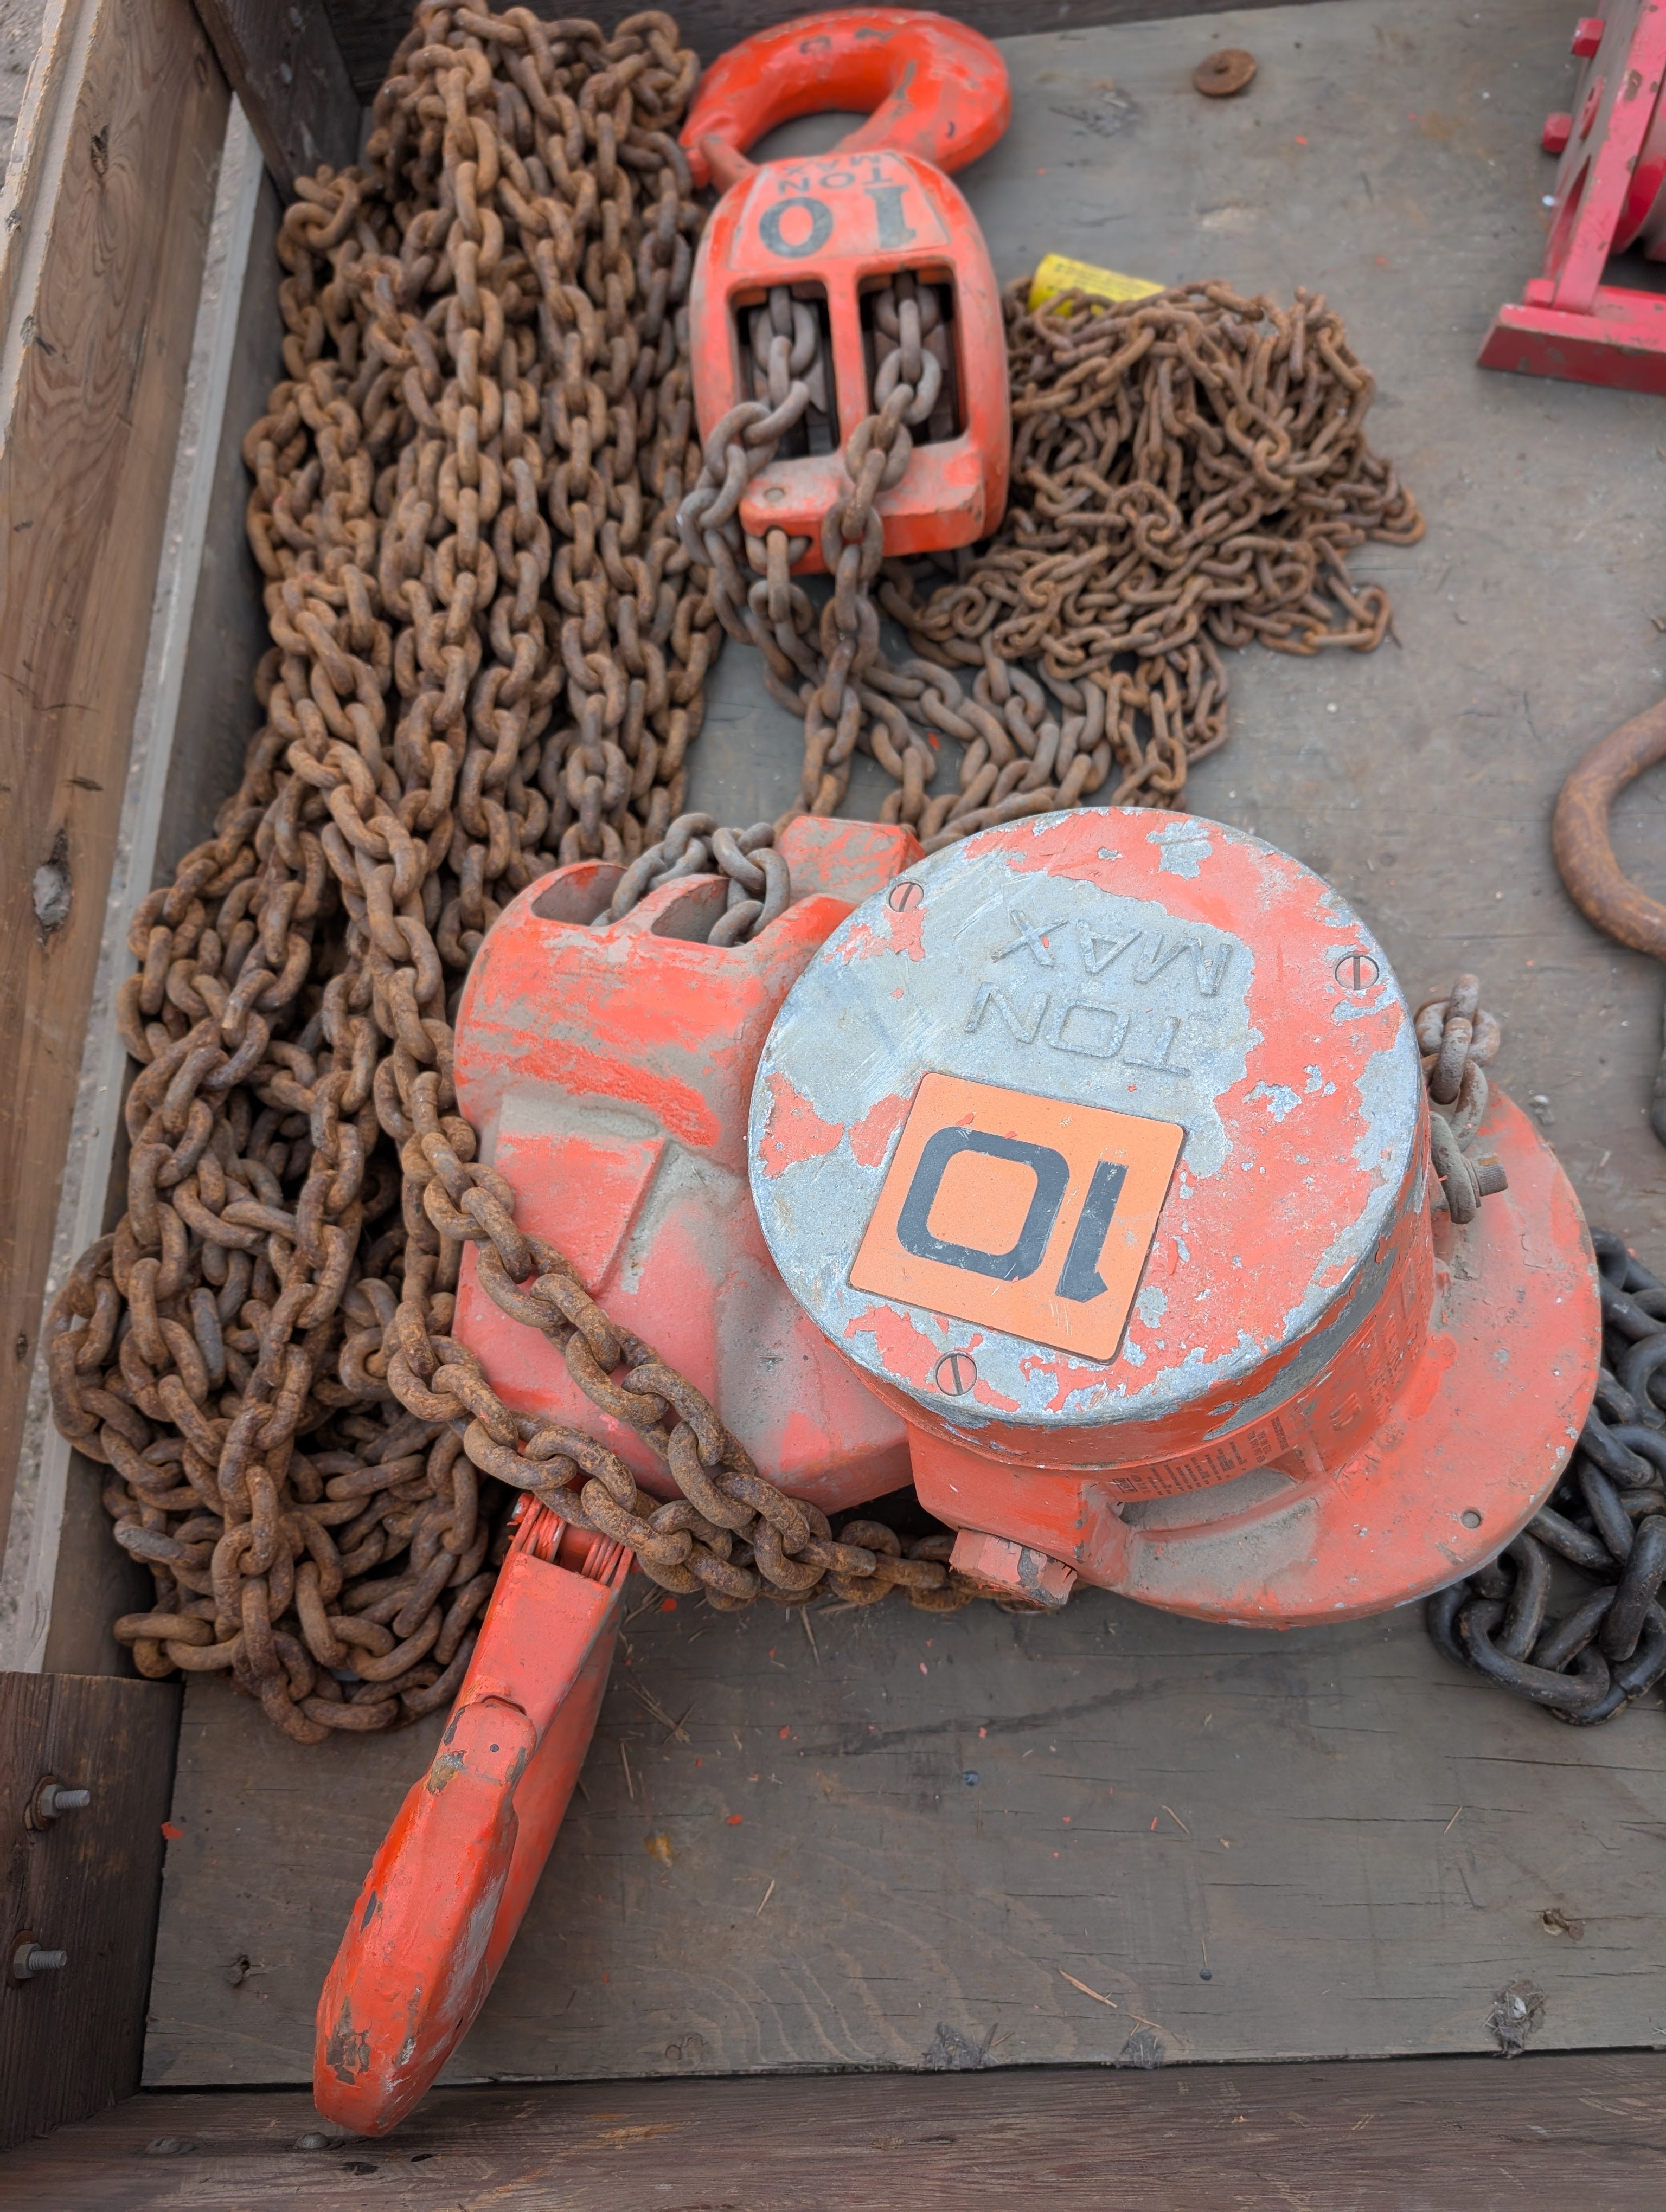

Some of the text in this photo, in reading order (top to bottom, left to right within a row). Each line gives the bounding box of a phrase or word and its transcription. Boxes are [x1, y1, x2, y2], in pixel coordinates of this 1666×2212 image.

[778, 166, 894, 195] TON
[784, 154, 881, 177] MAX
[759, 184, 917, 259] 10
[991, 910, 1233, 996] MAX
[964, 982, 1190, 1077] TON
[897, 1126, 1130, 1303] 10
